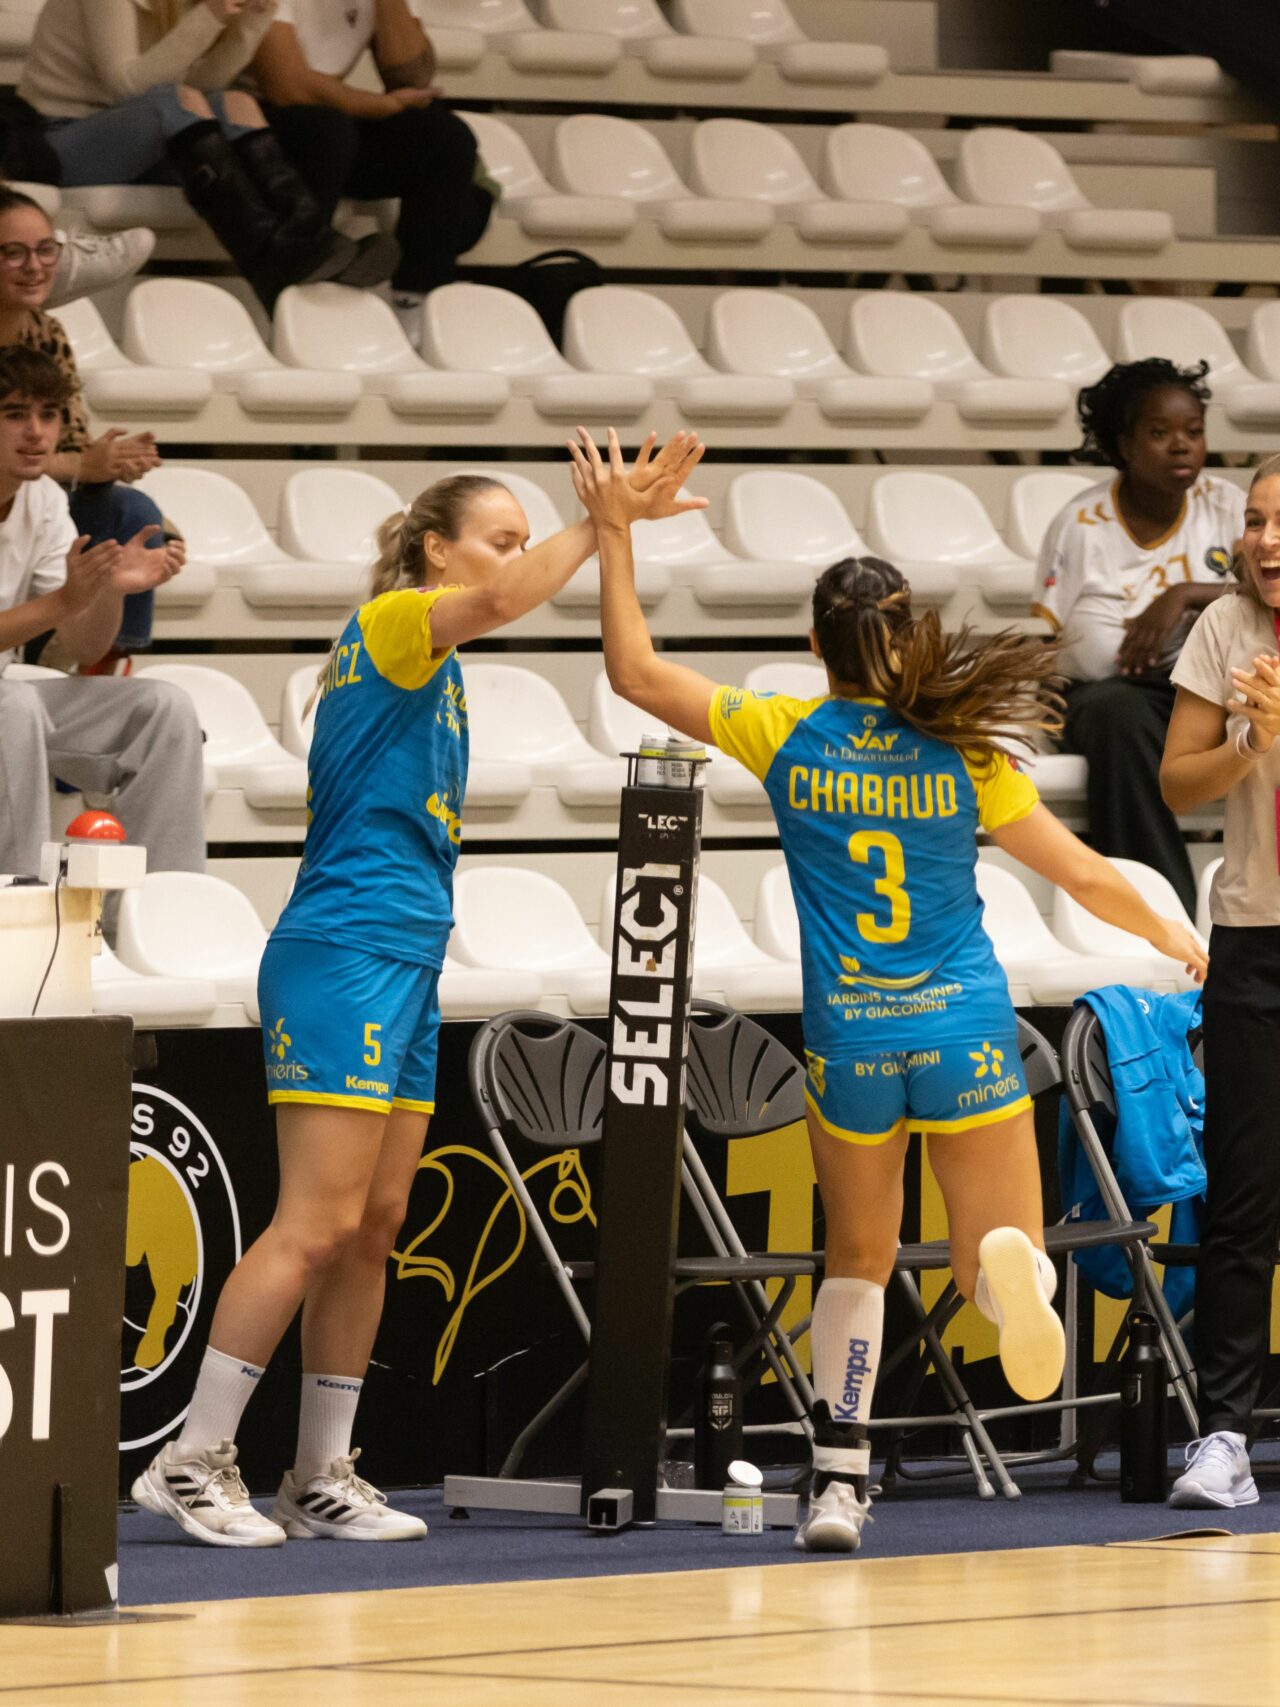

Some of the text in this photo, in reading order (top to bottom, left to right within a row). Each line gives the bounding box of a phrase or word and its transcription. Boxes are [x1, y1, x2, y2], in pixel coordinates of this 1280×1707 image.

[789, 766, 958, 819] CHABAUD
[848, 830, 911, 943] 3
[844, 1000, 947, 1021] BY GIACOMINI
[363, 1023, 382, 1066] 5
[855, 1063, 875, 1077] BY
[958, 1073, 1020, 1108] mineris
[168, 1125, 211, 1189] 92
[835, 1338, 872, 1422] Kempa
